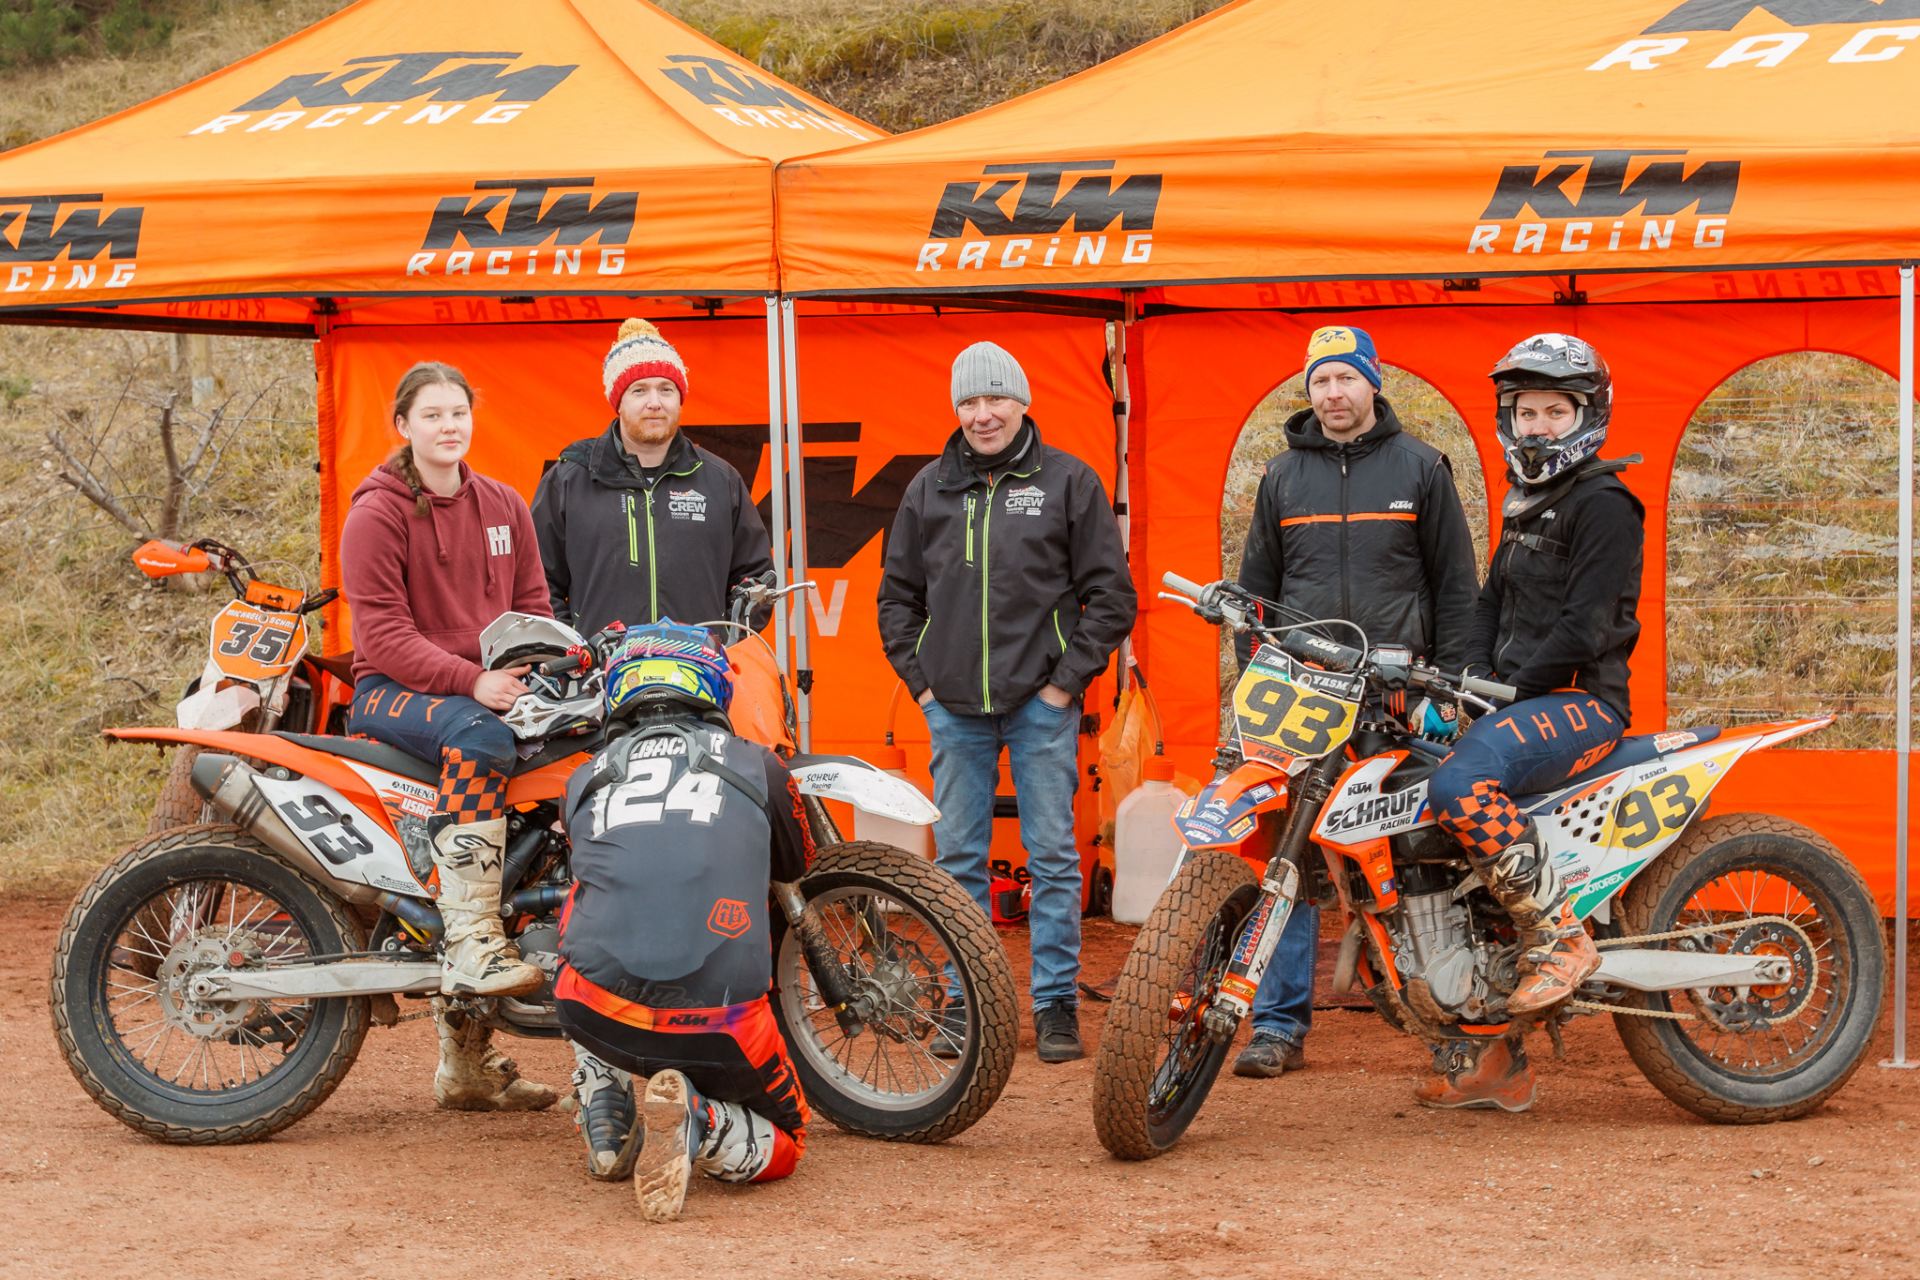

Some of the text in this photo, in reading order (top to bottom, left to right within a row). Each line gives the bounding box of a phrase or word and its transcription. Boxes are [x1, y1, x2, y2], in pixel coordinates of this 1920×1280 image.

[231, 52, 580, 113] KTM
[658, 55, 833, 121] KTM
[1478, 150, 1741, 220] KTM
[420, 176, 639, 249] KTM
[928, 160, 1163, 238] KTM
[668, 500, 707, 513] CREW
[1004, 496, 1045, 508] CREW
[1388, 500, 1414, 510] KTM
[218, 620, 292, 664] 35
[1305, 637, 1342, 655] KTM
[1312, 674, 1362, 694] YASMN
[1236, 678, 1348, 755] 93
[1255, 748, 1288, 764] KTM
[806, 772, 839, 782] SCHRUF
[1347, 781, 1373, 796] KTM
[400, 783, 436, 801] ATHENA
[591, 754, 724, 838] 124
[1325, 787, 1421, 834] SCHRUF
[1379, 816, 1411, 832] RACING
[1615, 774, 1698, 850] 93
[277, 794, 374, 866] 93
[1578, 871, 1625, 898] MOTOREX
[667, 1013, 710, 1025] KTM
